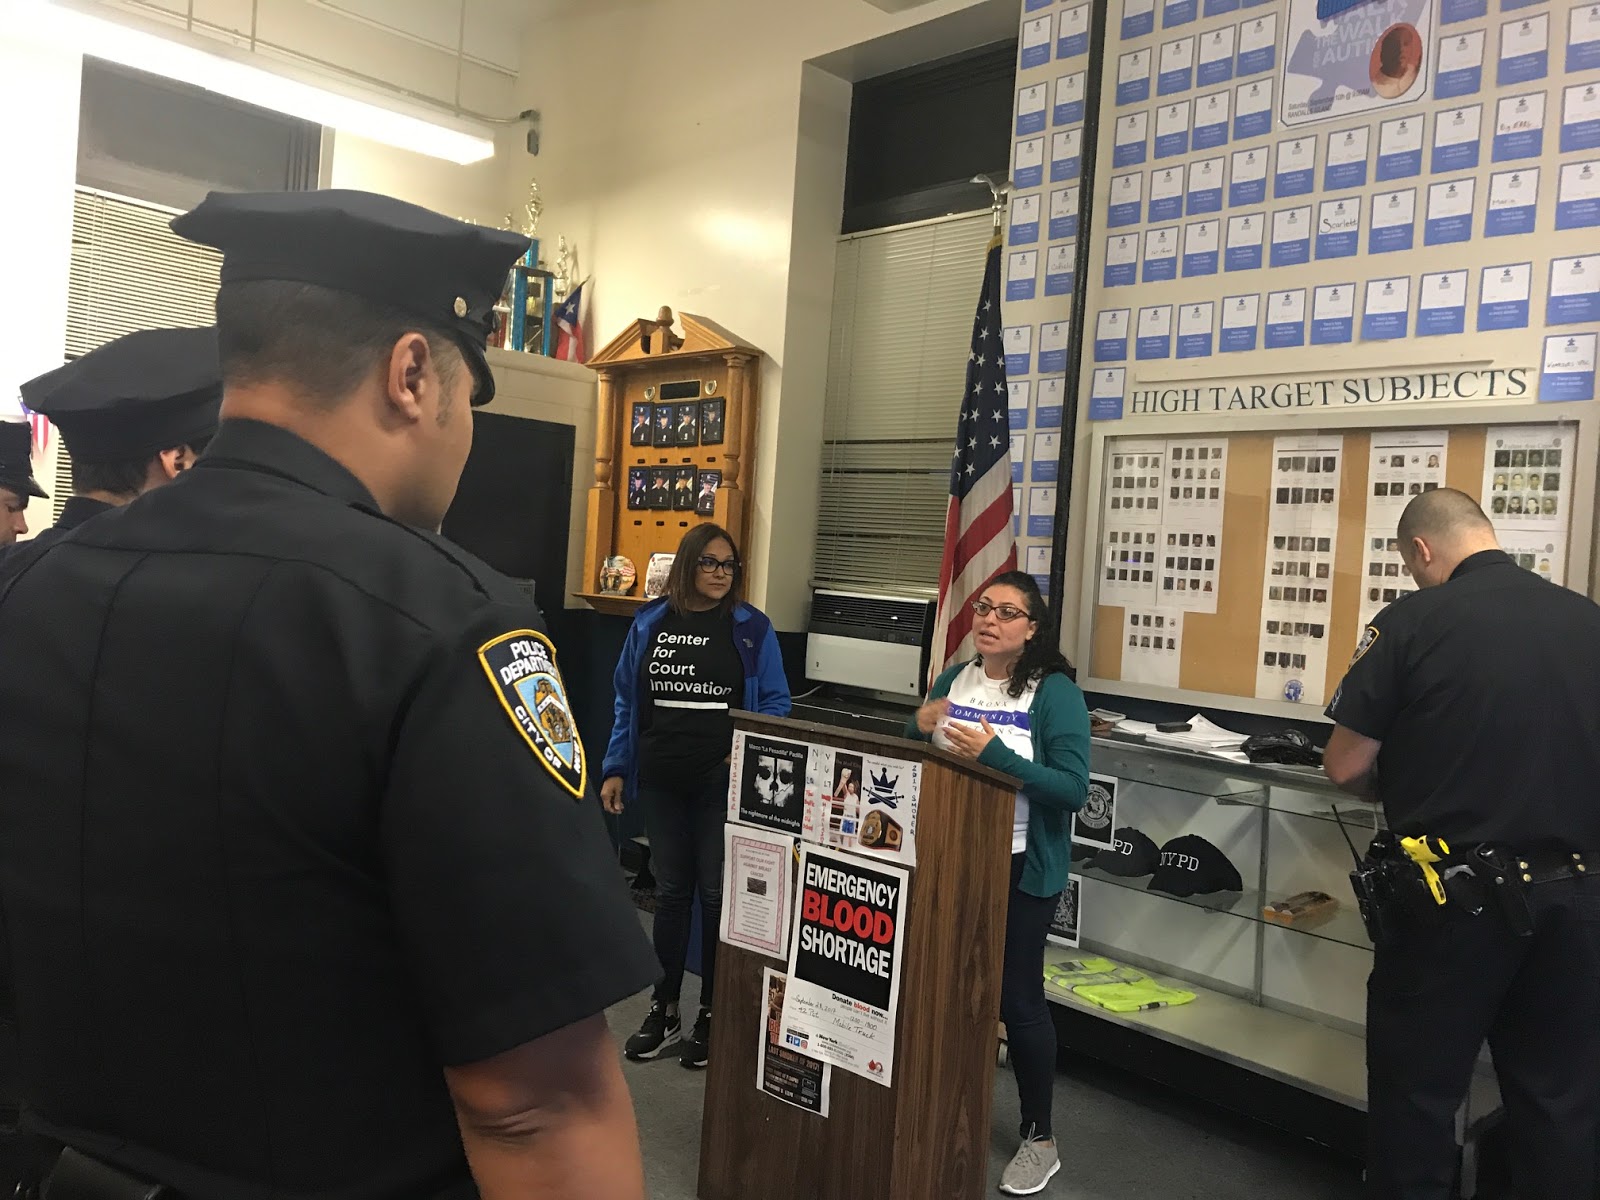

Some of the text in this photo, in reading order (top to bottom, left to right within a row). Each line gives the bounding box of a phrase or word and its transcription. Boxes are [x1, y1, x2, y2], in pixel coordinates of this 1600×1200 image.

[1319, 218, 1360, 234] Scarlett
[1131, 367, 1528, 414] HIGH TARGET SUBJECTS
[657, 631, 710, 646] Center
[510, 640, 548, 660] POLICE
[652, 646, 676, 659] for
[648, 661, 695, 676] Court
[649, 679, 732, 696] Innovation
[969, 697, 1008, 708] BRONX
[514, 705, 544, 744] CITY
[1112, 838, 1134, 856] PD
[1159, 851, 1200, 872] NYPD
[806, 862, 898, 910] EMERGENCY
[803, 888, 894, 945] BLOOD
[801, 924, 891, 979] SHORTAGE
[831, 993, 853, 1007] Donate
[853, 1001, 871, 1013] blood
[853, 1026, 877, 1040] Truck
